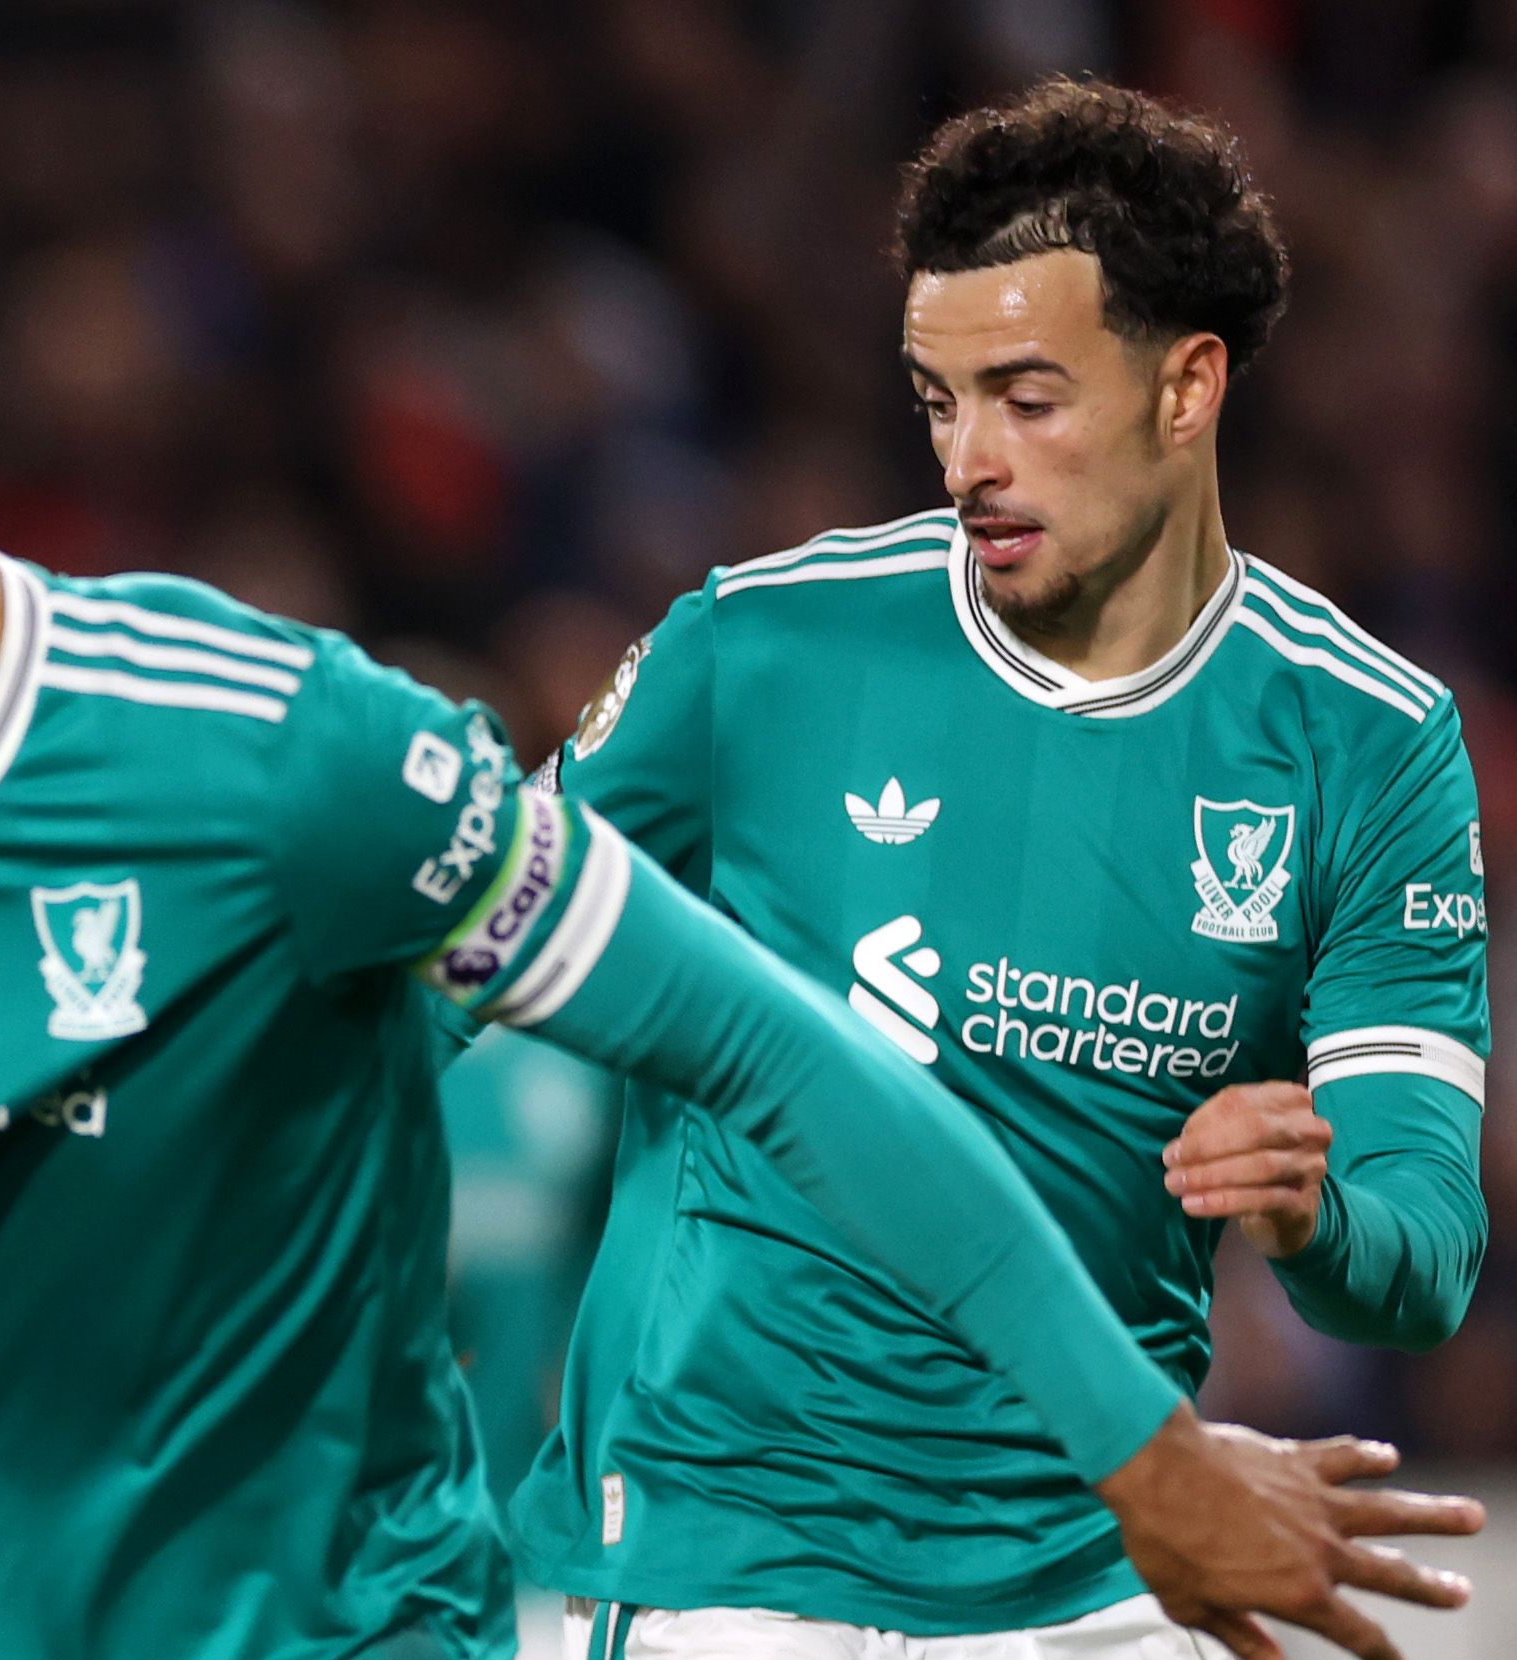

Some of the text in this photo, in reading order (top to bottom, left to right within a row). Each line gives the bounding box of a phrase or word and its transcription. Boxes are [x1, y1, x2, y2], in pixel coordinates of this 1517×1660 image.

[1196, 919, 1274, 938] FOOTBALL CLUB
[1201, 878, 1278, 923] LIVER POOL
[966, 956, 1239, 1039] standard
[961, 1008, 1240, 1078] chartered
